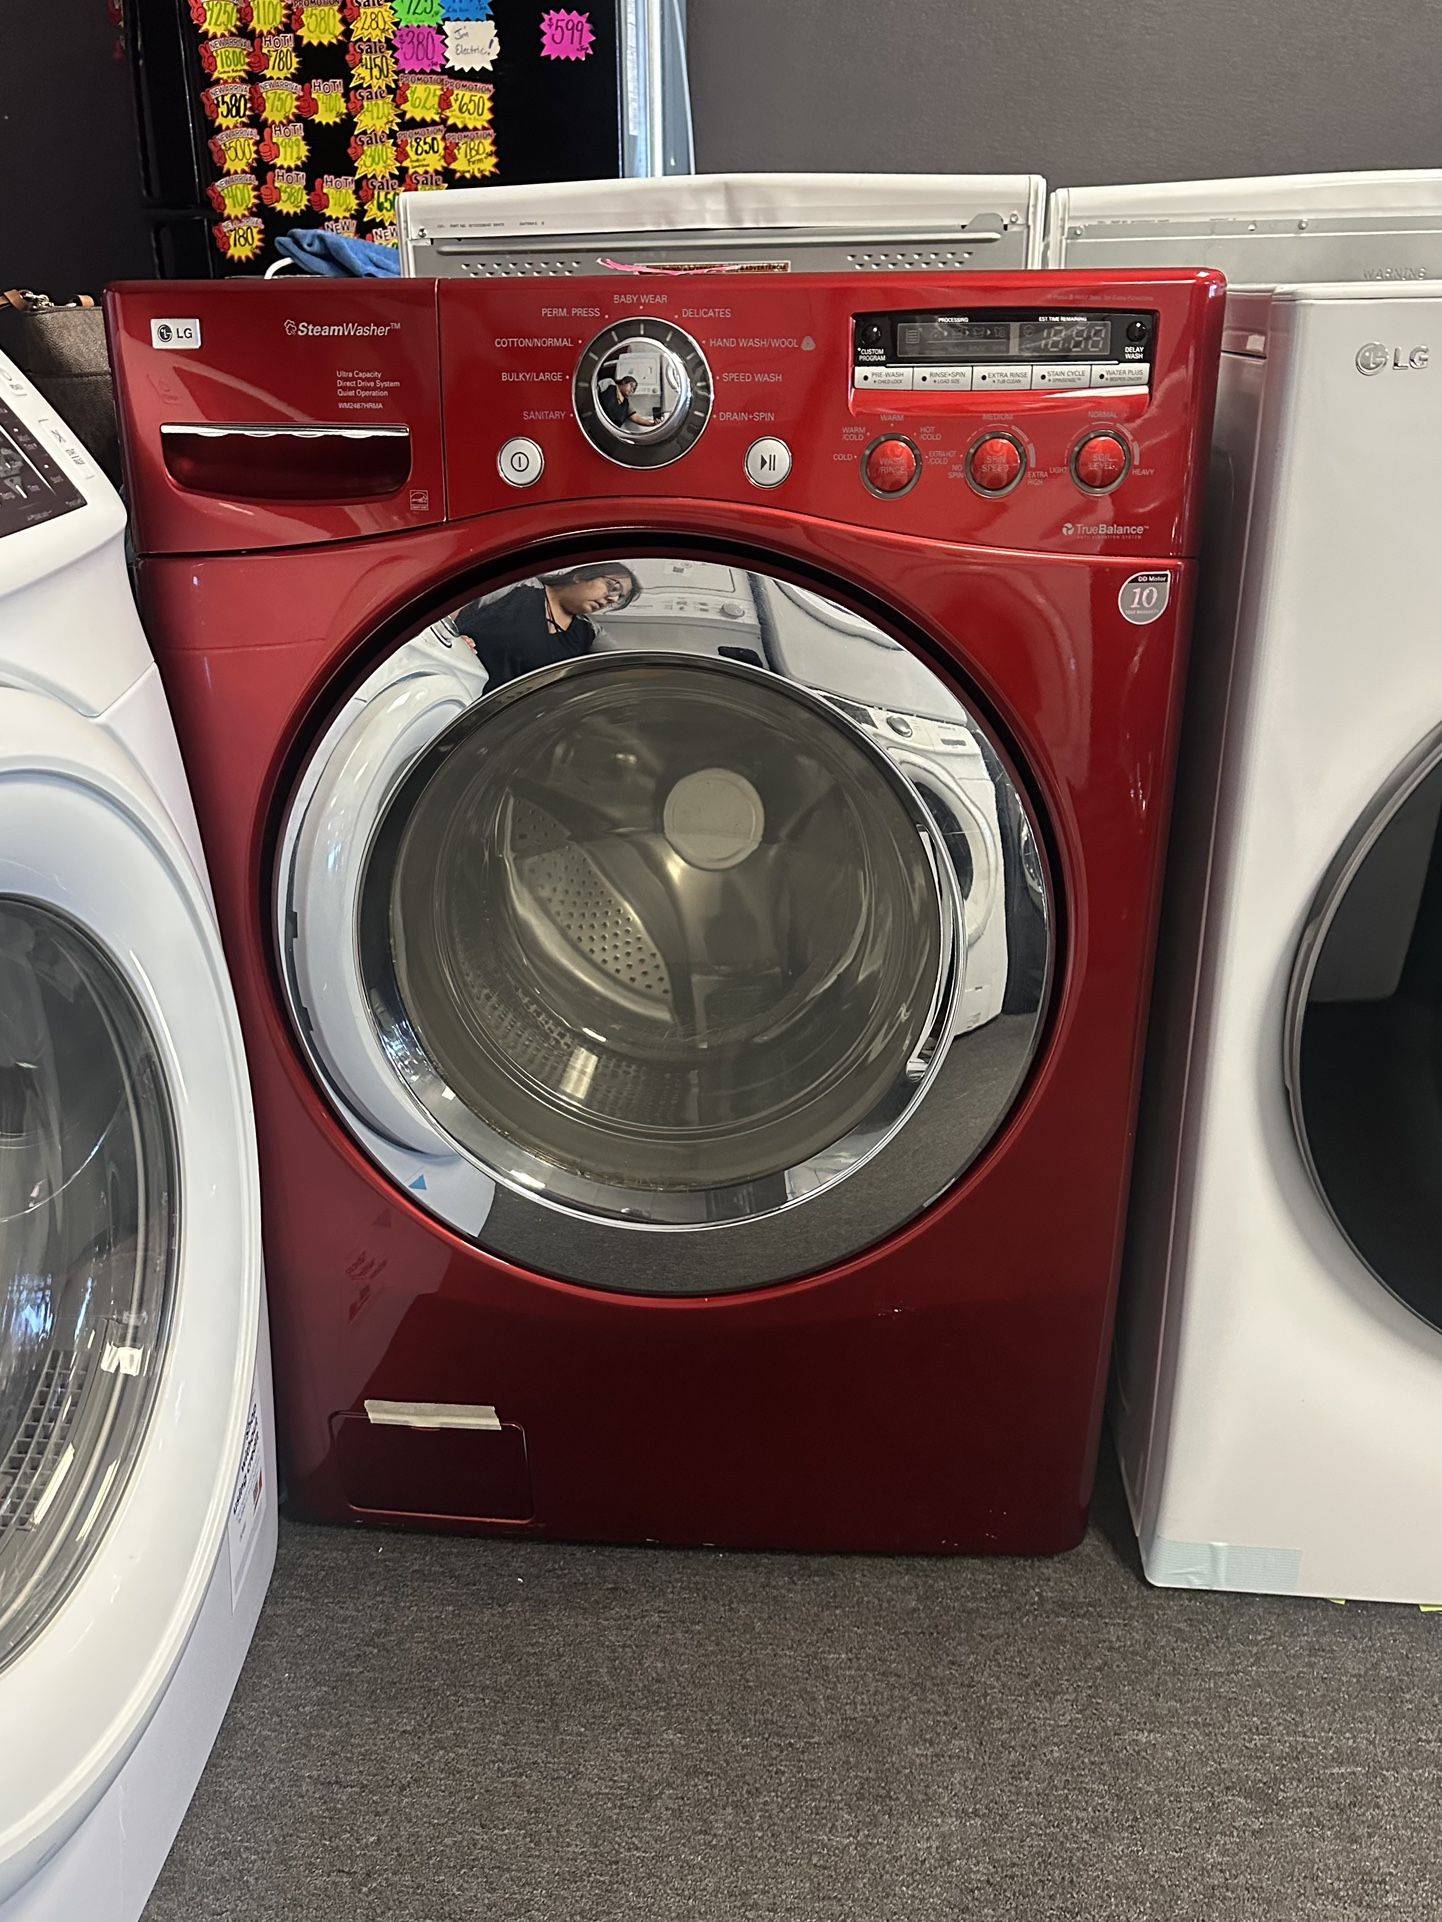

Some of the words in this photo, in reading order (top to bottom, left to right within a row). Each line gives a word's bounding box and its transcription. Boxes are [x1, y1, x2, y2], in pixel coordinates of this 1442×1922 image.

[547, 17, 584, 45] $599
[263, 35, 294, 48] HOT!
[399, 31, 435, 61] $380
[454, 92, 485, 117] $650
[274, 124, 303, 137] HOT!
[276, 171, 305, 184] HOT!
[613, 295, 639, 304] BABY
[640, 295, 668, 304] WEAR
[541, 307, 569, 317] PERM.
[571, 307, 601, 317] PRESS
[682, 309, 732, 318] DELICATES
[176, 328, 193, 339] LG
[494, 338, 574, 348] COTTON/NORMAL
[709, 338, 737, 348] HAND
[738, 338, 799, 348] WASH/WOOL
[1392, 345, 1430, 371] LG
[336, 370, 353, 378] Ultra
[354, 370, 382, 380] Capacity
[501, 372, 563, 382] BULKY/LARGE
[722, 373, 752, 382] SPEED
[753, 373, 783, 382] WASH
[336, 380, 356, 388] Direct
[357, 380, 375, 388] Drive
[376, 380, 401, 389] System
[337, 389, 355, 397] Quiet
[356, 389, 389, 398] Operation
[523, 411, 566, 420] SANITARY
[719, 412, 775, 421] DRAIN+SPIN
[879, 458, 904, 466] WASH
[1130, 587, 1158, 608] 10
